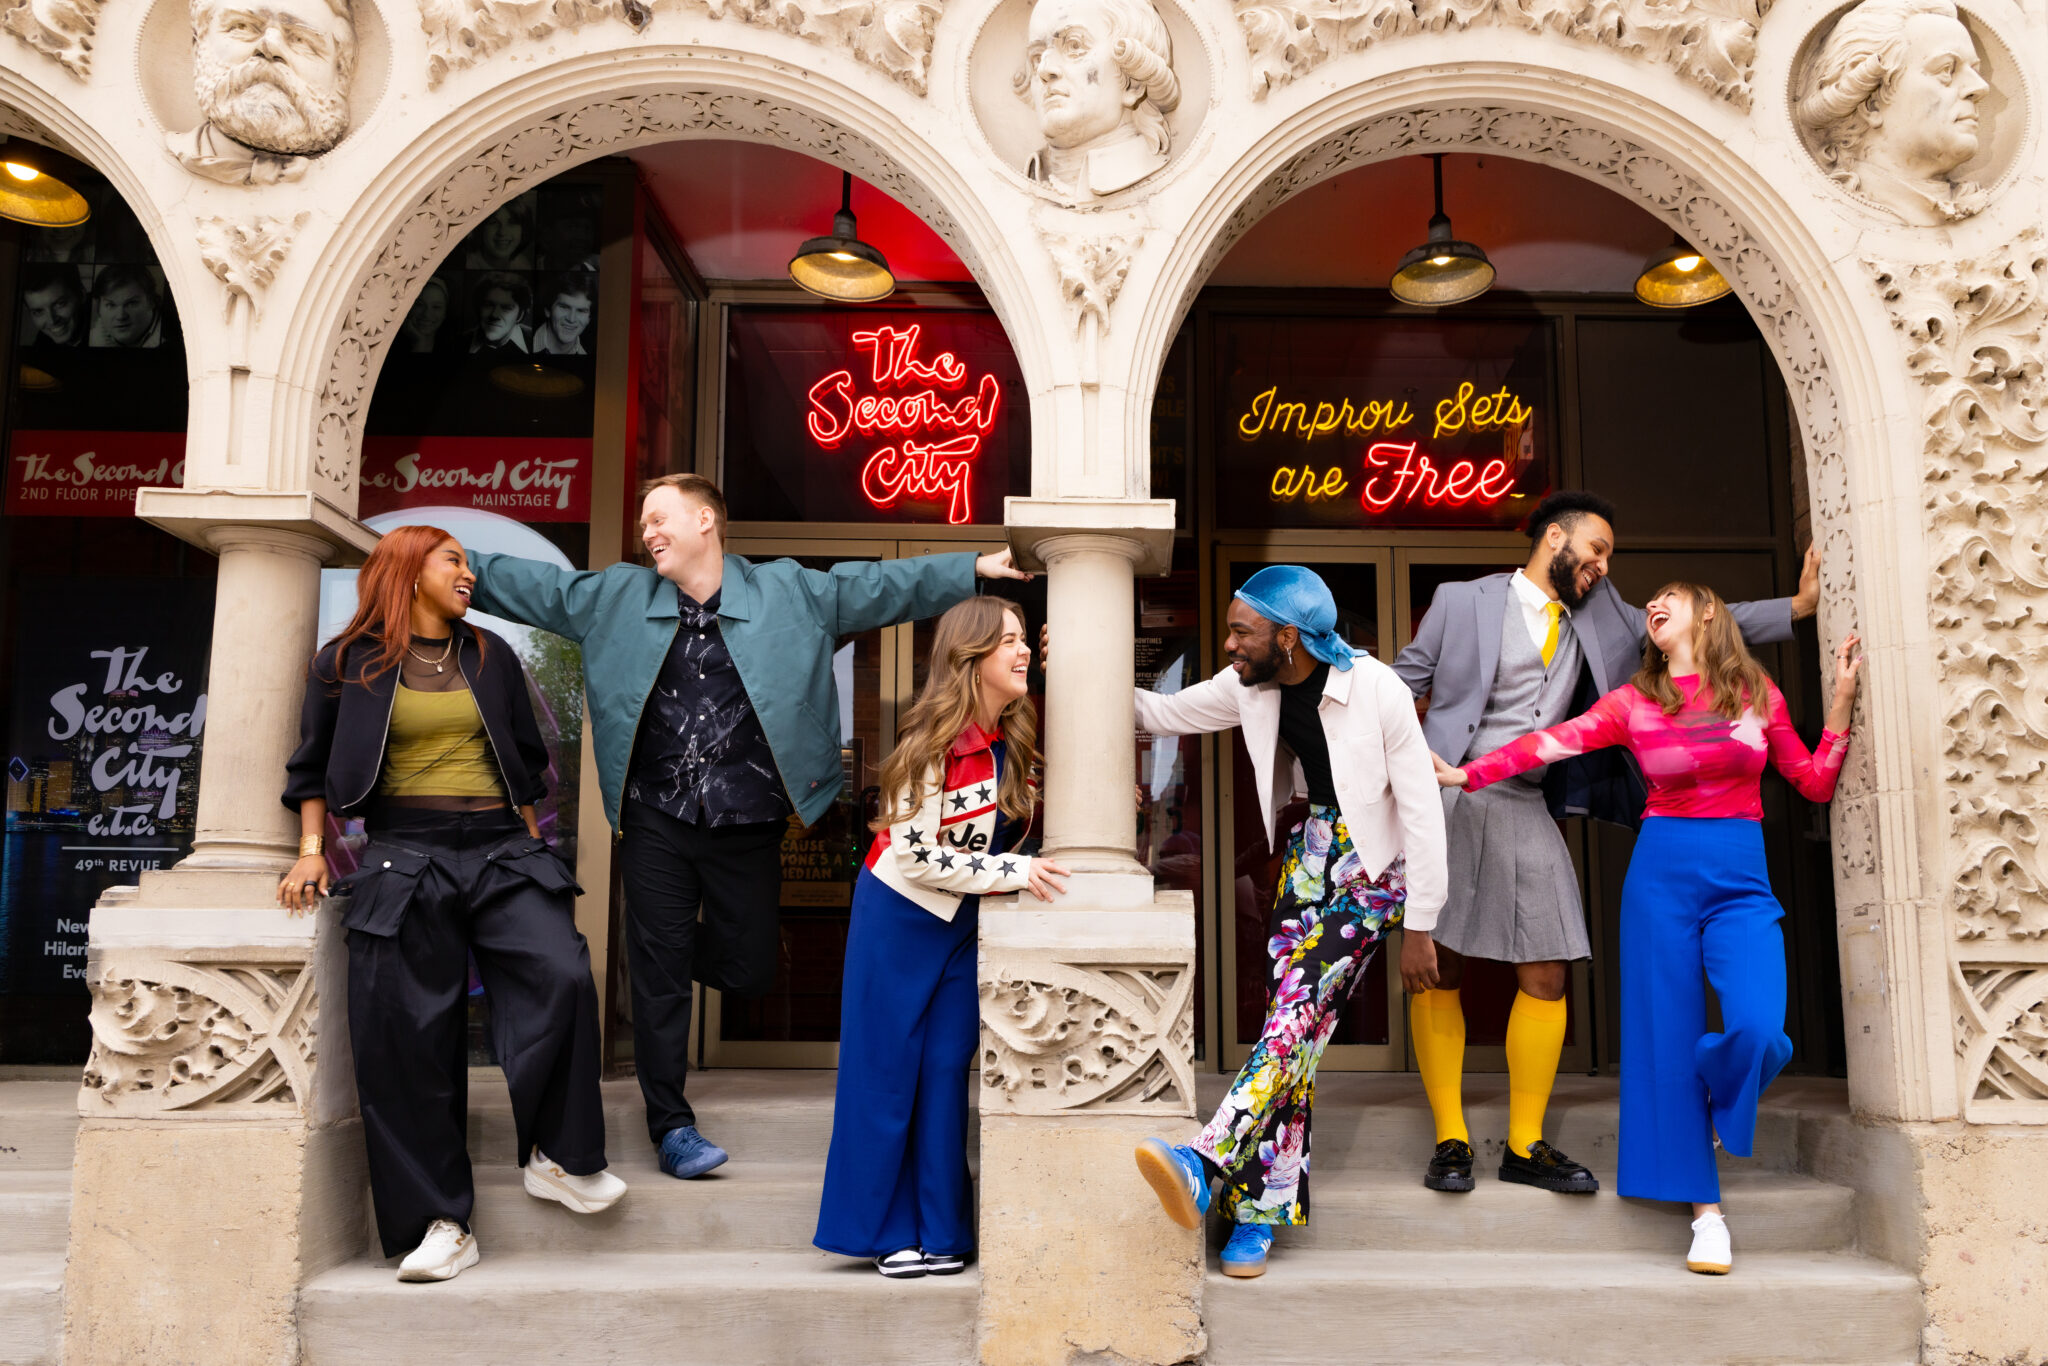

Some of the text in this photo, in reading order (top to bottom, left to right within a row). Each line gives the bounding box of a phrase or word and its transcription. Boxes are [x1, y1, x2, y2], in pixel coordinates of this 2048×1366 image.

[853, 325, 966, 383] The
[808, 371, 999, 442] Second
[1240, 382, 1532, 440] Improv Sets
[16, 453, 71, 483] The
[71, 451, 169, 486] Second
[20, 487, 49, 499] 2ND
[56, 487, 99, 500] FLOOR
[393, 453, 506, 493] Second
[509, 457, 579, 510] City
[863, 435, 979, 524] City
[1271, 441, 1515, 506] are Free
[472, 493, 552, 507] MAINSTAGE
[90, 646, 183, 694] The
[48, 682, 208, 741] Second
[91, 742, 193, 820] City
[88, 804, 156, 837] e.t.c.
[75, 858, 160, 872] 49th REVUE
